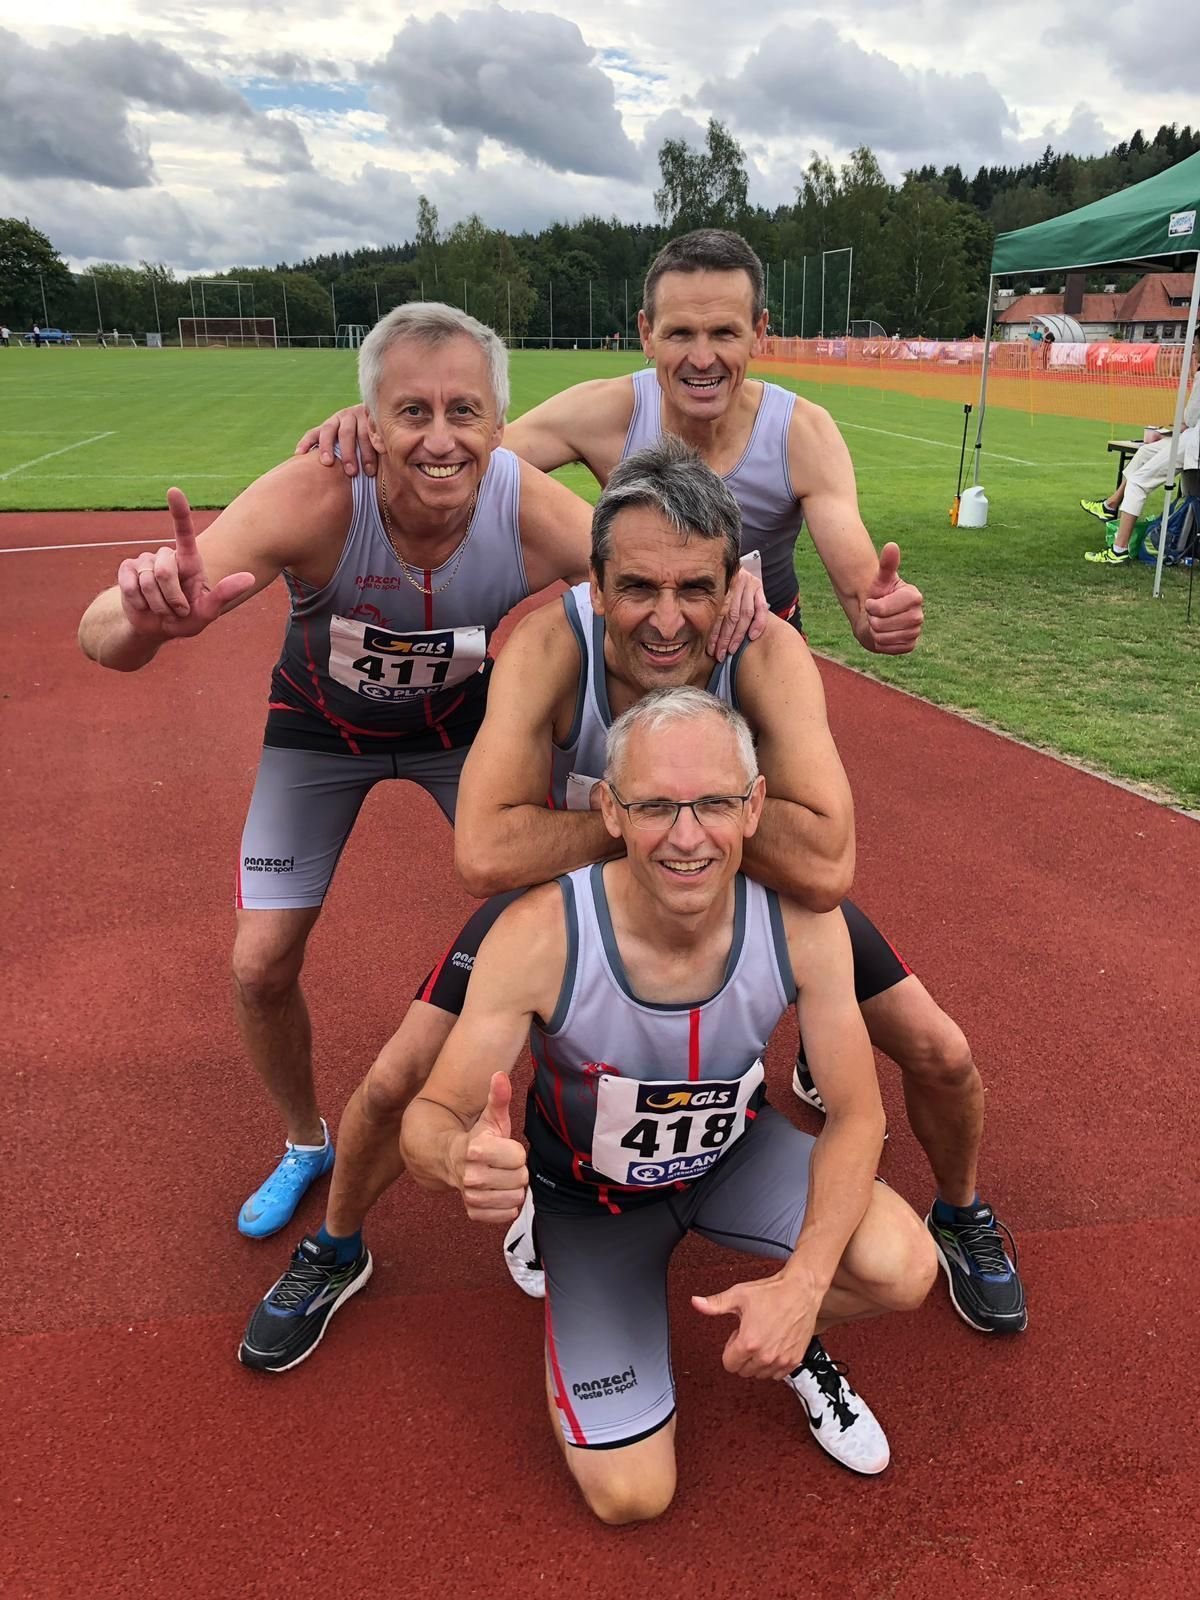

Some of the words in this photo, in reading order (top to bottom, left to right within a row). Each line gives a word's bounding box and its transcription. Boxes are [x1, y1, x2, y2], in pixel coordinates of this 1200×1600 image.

[411, 642, 448, 655] GLS
[352, 654, 450, 685] 411
[394, 686, 438, 697] PLAN
[244, 856, 295, 866] panzeri
[690, 1090, 731, 1105] GLS
[620, 1111, 737, 1158] 418
[668, 1154, 718, 1174] PLAN
[572, 1365, 636, 1396] panzeri
[578, 1390, 603, 1401] veste
[604, 1388, 614, 1396] lo
[615, 1378, 638, 1394] sport
